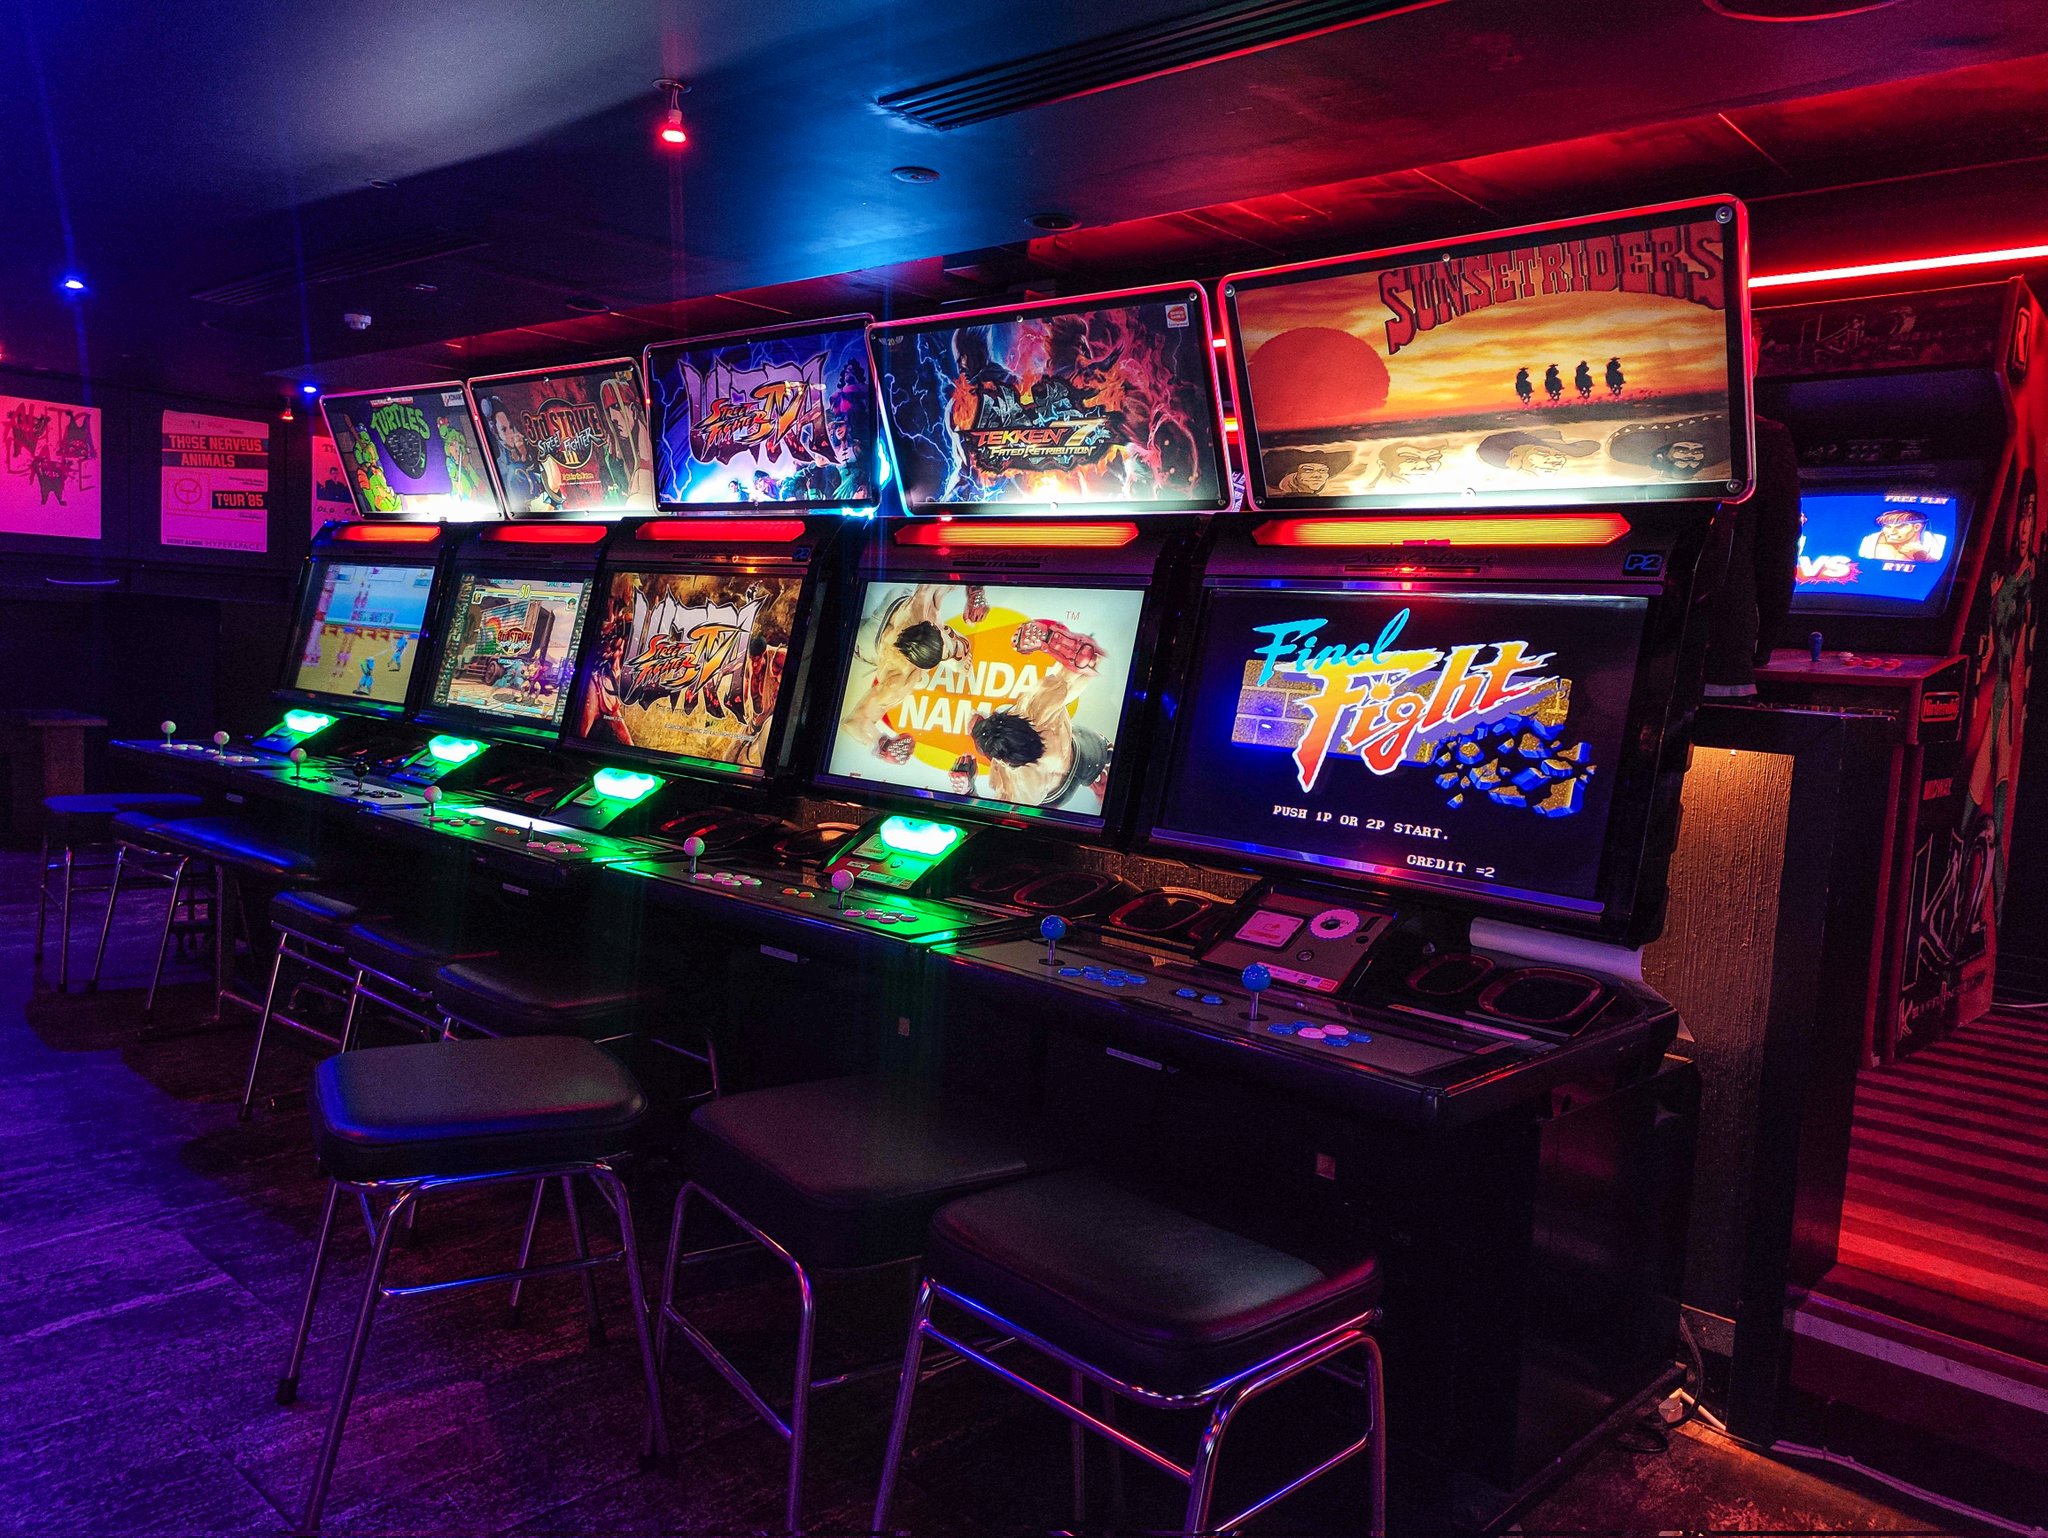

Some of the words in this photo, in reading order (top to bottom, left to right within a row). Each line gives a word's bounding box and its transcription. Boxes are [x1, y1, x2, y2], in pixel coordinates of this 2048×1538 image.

[370, 402, 431, 444] TURTLES
[679, 351, 842, 466] ULTRA
[695, 398, 757, 428] STREET
[522, 412, 550, 443] 3rd
[549, 405, 604, 440] STRIKE
[700, 411, 771, 456] FIGHTER
[970, 428, 1070, 447] TEKKEN
[1048, 417, 1108, 447] 7
[168, 434, 207, 450] THOSE
[208, 436, 263, 452] NERVOUS
[537, 430, 562, 458] STREET
[563, 426, 604, 453] FIGHTER
[987, 445, 1025, 459] FATED
[1022, 444, 1097, 459] RETRIBUTION
[181, 453, 236, 468] ANIMALS
[561, 450, 581, 465] III
[215, 493, 246, 507] TOUR
[1884, 495, 1919, 503] FREE
[1919, 496, 1949, 505] PLAY
[1624, 554, 1663, 571] P2
[1799, 555, 1851, 578] VS
[1881, 563, 1916, 573] RYU
[1065, 610, 1081, 621] TM
[618, 584, 770, 726] ULTRA
[628, 634, 690, 665] STREET
[1252, 607, 1411, 688] Final
[628, 653, 699, 696] FIGHTER
[897, 694, 1018, 736] NAM
[1272, 639, 1560, 793] Fight
[1273, 804, 1308, 820] PUSH
[1315, 810, 1334, 824] 1P
[1340, 813, 1359, 828] OR
[1366, 817, 1386, 832] 2P
[1393, 822, 1448, 841] START.
[1406, 854, 1467, 874] CREDIT
